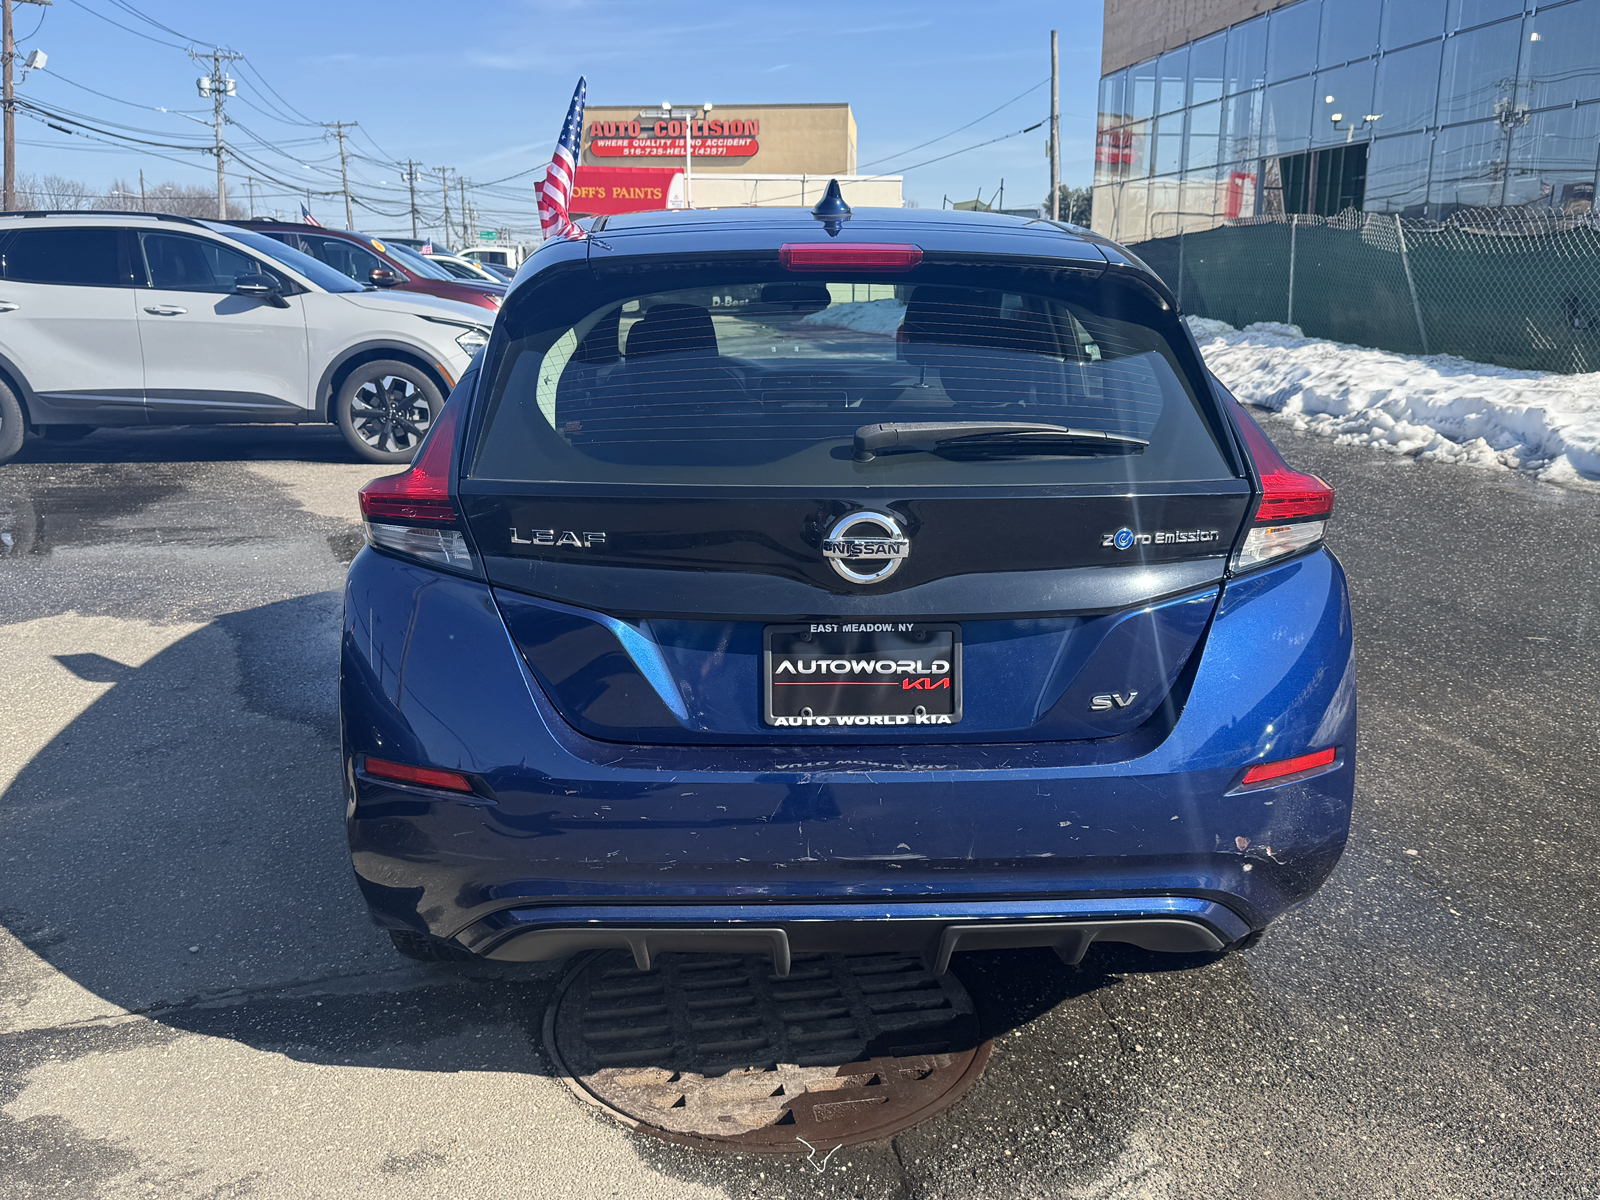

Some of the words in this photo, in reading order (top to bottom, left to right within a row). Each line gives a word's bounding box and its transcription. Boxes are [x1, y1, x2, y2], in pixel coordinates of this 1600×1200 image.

[590, 121, 641, 137] AUTO
[597, 139, 629, 147] WHERE
[632, 139, 672, 147] QUALITY
[675, 139, 685, 147] IS
[688, 139, 702, 147] NO
[706, 138, 752, 147] ACCIDENT
[695, 147, 727, 156] (4357)
[612, 187, 662, 199] PAINTS
[509, 527, 606, 547] LEAF
[1154, 529, 1219, 544] Emission
[832, 543, 901, 555] NISSAN
[810, 624, 839, 633] EAST
[898, 623, 914, 632] NY
[775, 659, 950, 675] AUTOWORLD
[902, 678, 950, 690] KIA
[1091, 692, 1138, 710] SV
[774, 716, 830, 726] AUTO
[836, 715, 909, 725] WORLD
[915, 715, 952, 725] KIA
